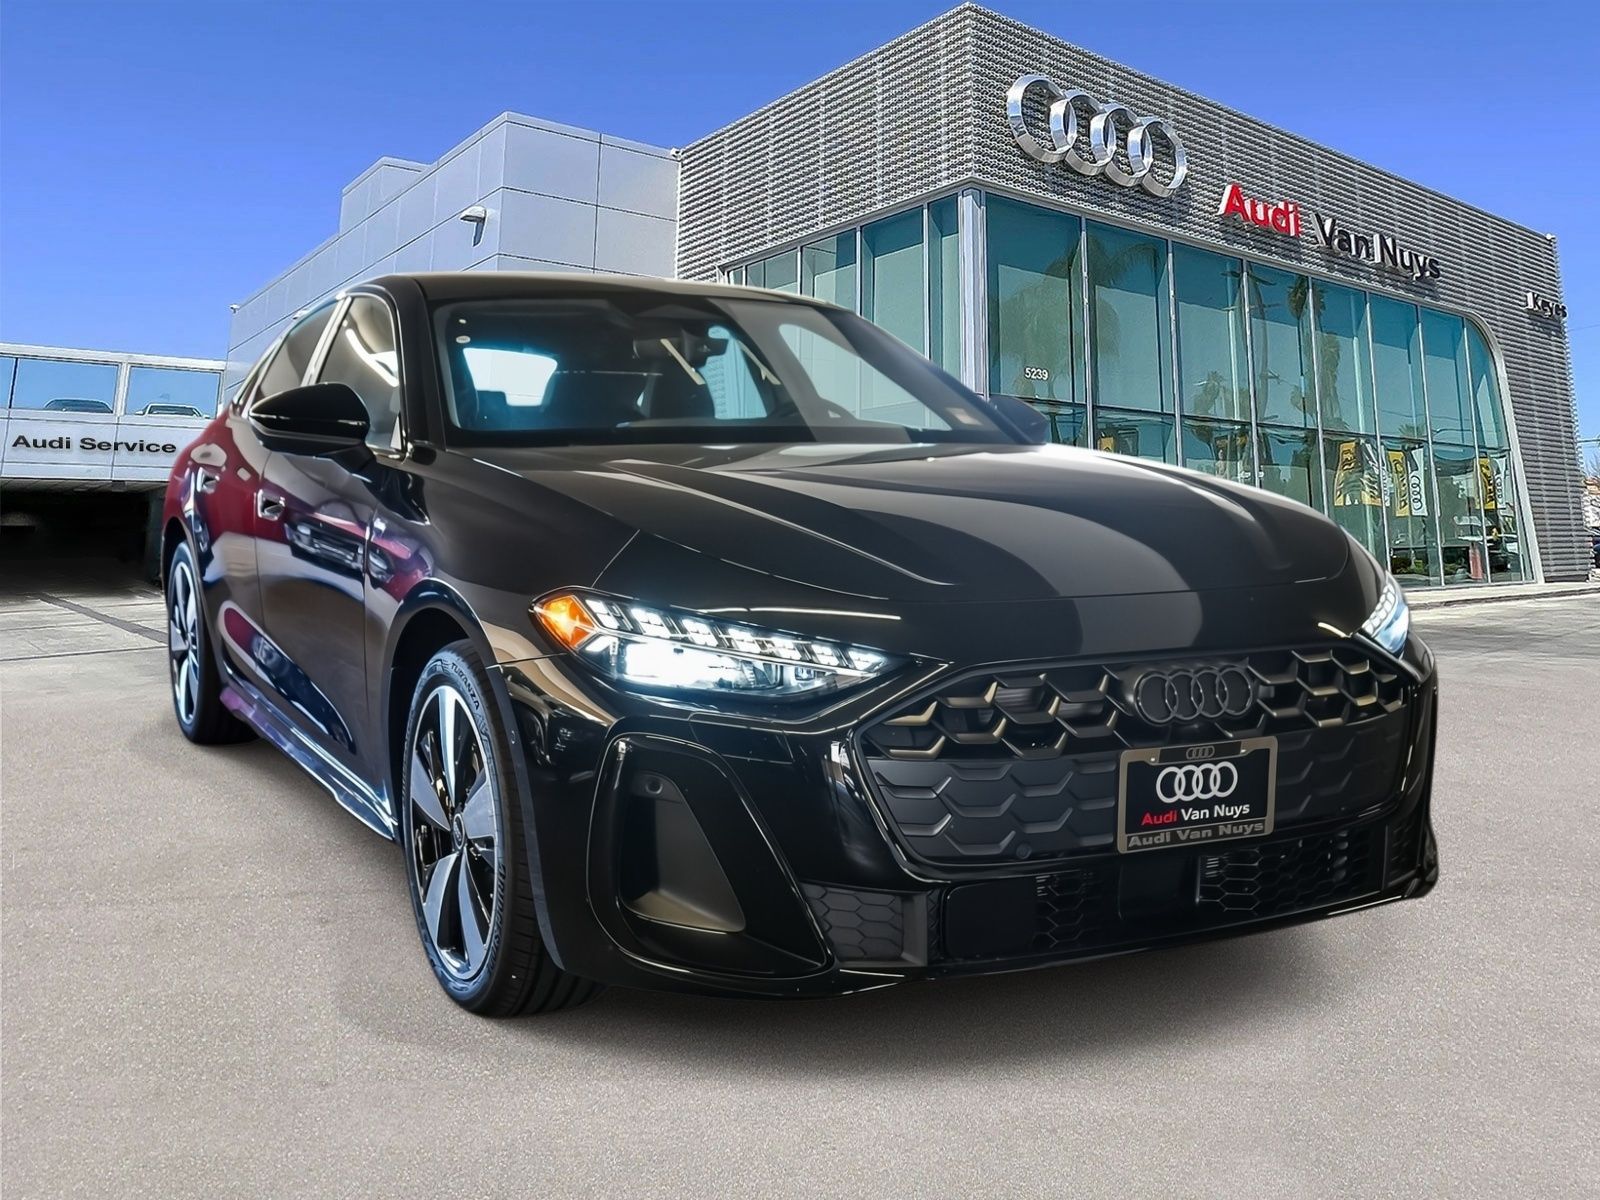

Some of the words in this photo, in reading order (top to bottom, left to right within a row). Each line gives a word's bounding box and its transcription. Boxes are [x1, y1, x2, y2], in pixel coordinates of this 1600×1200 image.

[1218, 183, 1302, 237] Audi
[1311, 212, 1370, 259] Van
[1373, 233, 1441, 281] Nuys
[1024, 367, 1049, 381] 5239
[12, 434, 71, 450] Audi
[79, 437, 177, 454] Service
[451, 662, 480, 711] TURANZA
[1141, 810, 1178, 826] Audi
[1181, 808, 1210, 821] Van
[1213, 804, 1250, 819] Nuys
[1128, 832, 1171, 848] Audi
[1176, 828, 1213, 842] Van
[1218, 821, 1264, 836] Nuys
